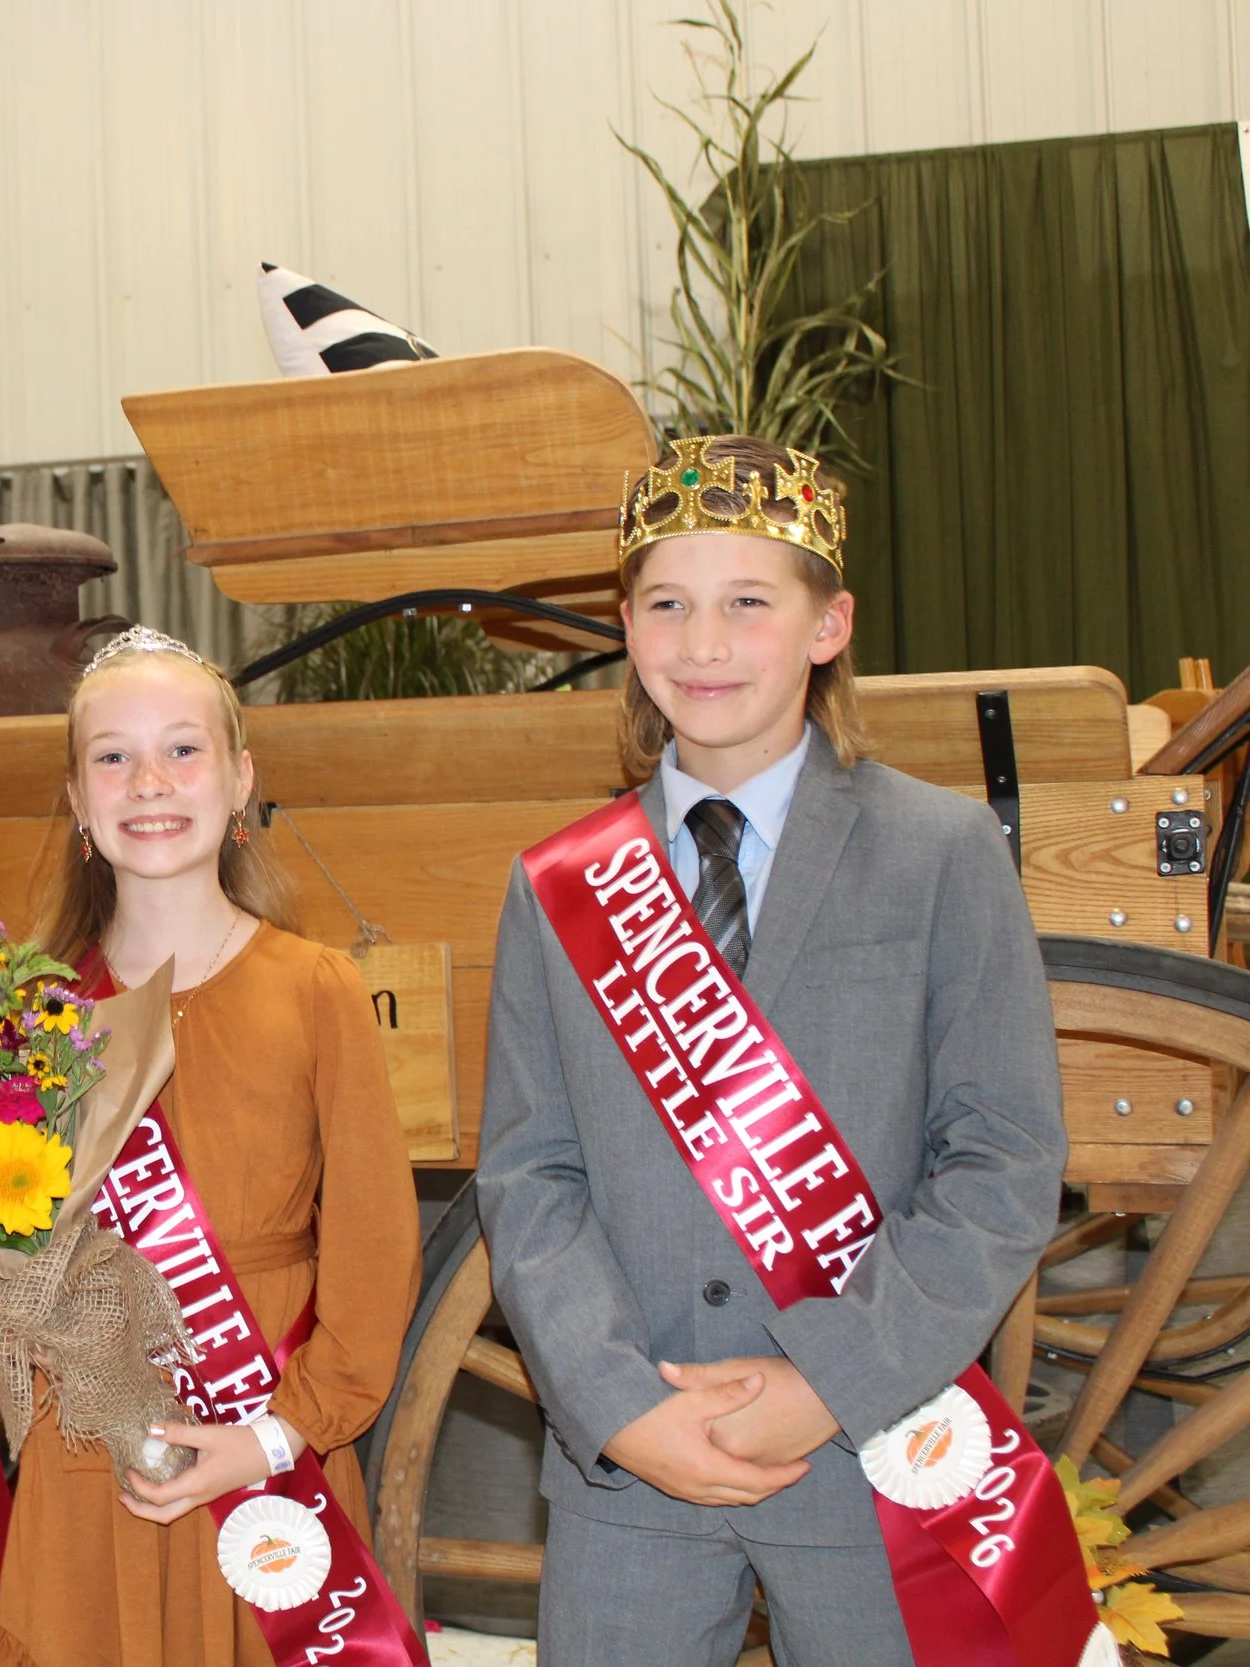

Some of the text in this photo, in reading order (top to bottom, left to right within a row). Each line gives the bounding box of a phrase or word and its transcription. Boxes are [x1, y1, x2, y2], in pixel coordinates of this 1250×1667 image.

[584, 836, 849, 1210] SPENCERVILLE
[592, 959, 795, 1273] LITTLE SIR
[911, 1416, 953, 1476] SPENCERVILLE FAIR
[968, 1428, 1021, 1569] 2026
[247, 1546, 302, 1570] SPENCERVILLE FAIR
[305, 1575, 368, 1666] 202
